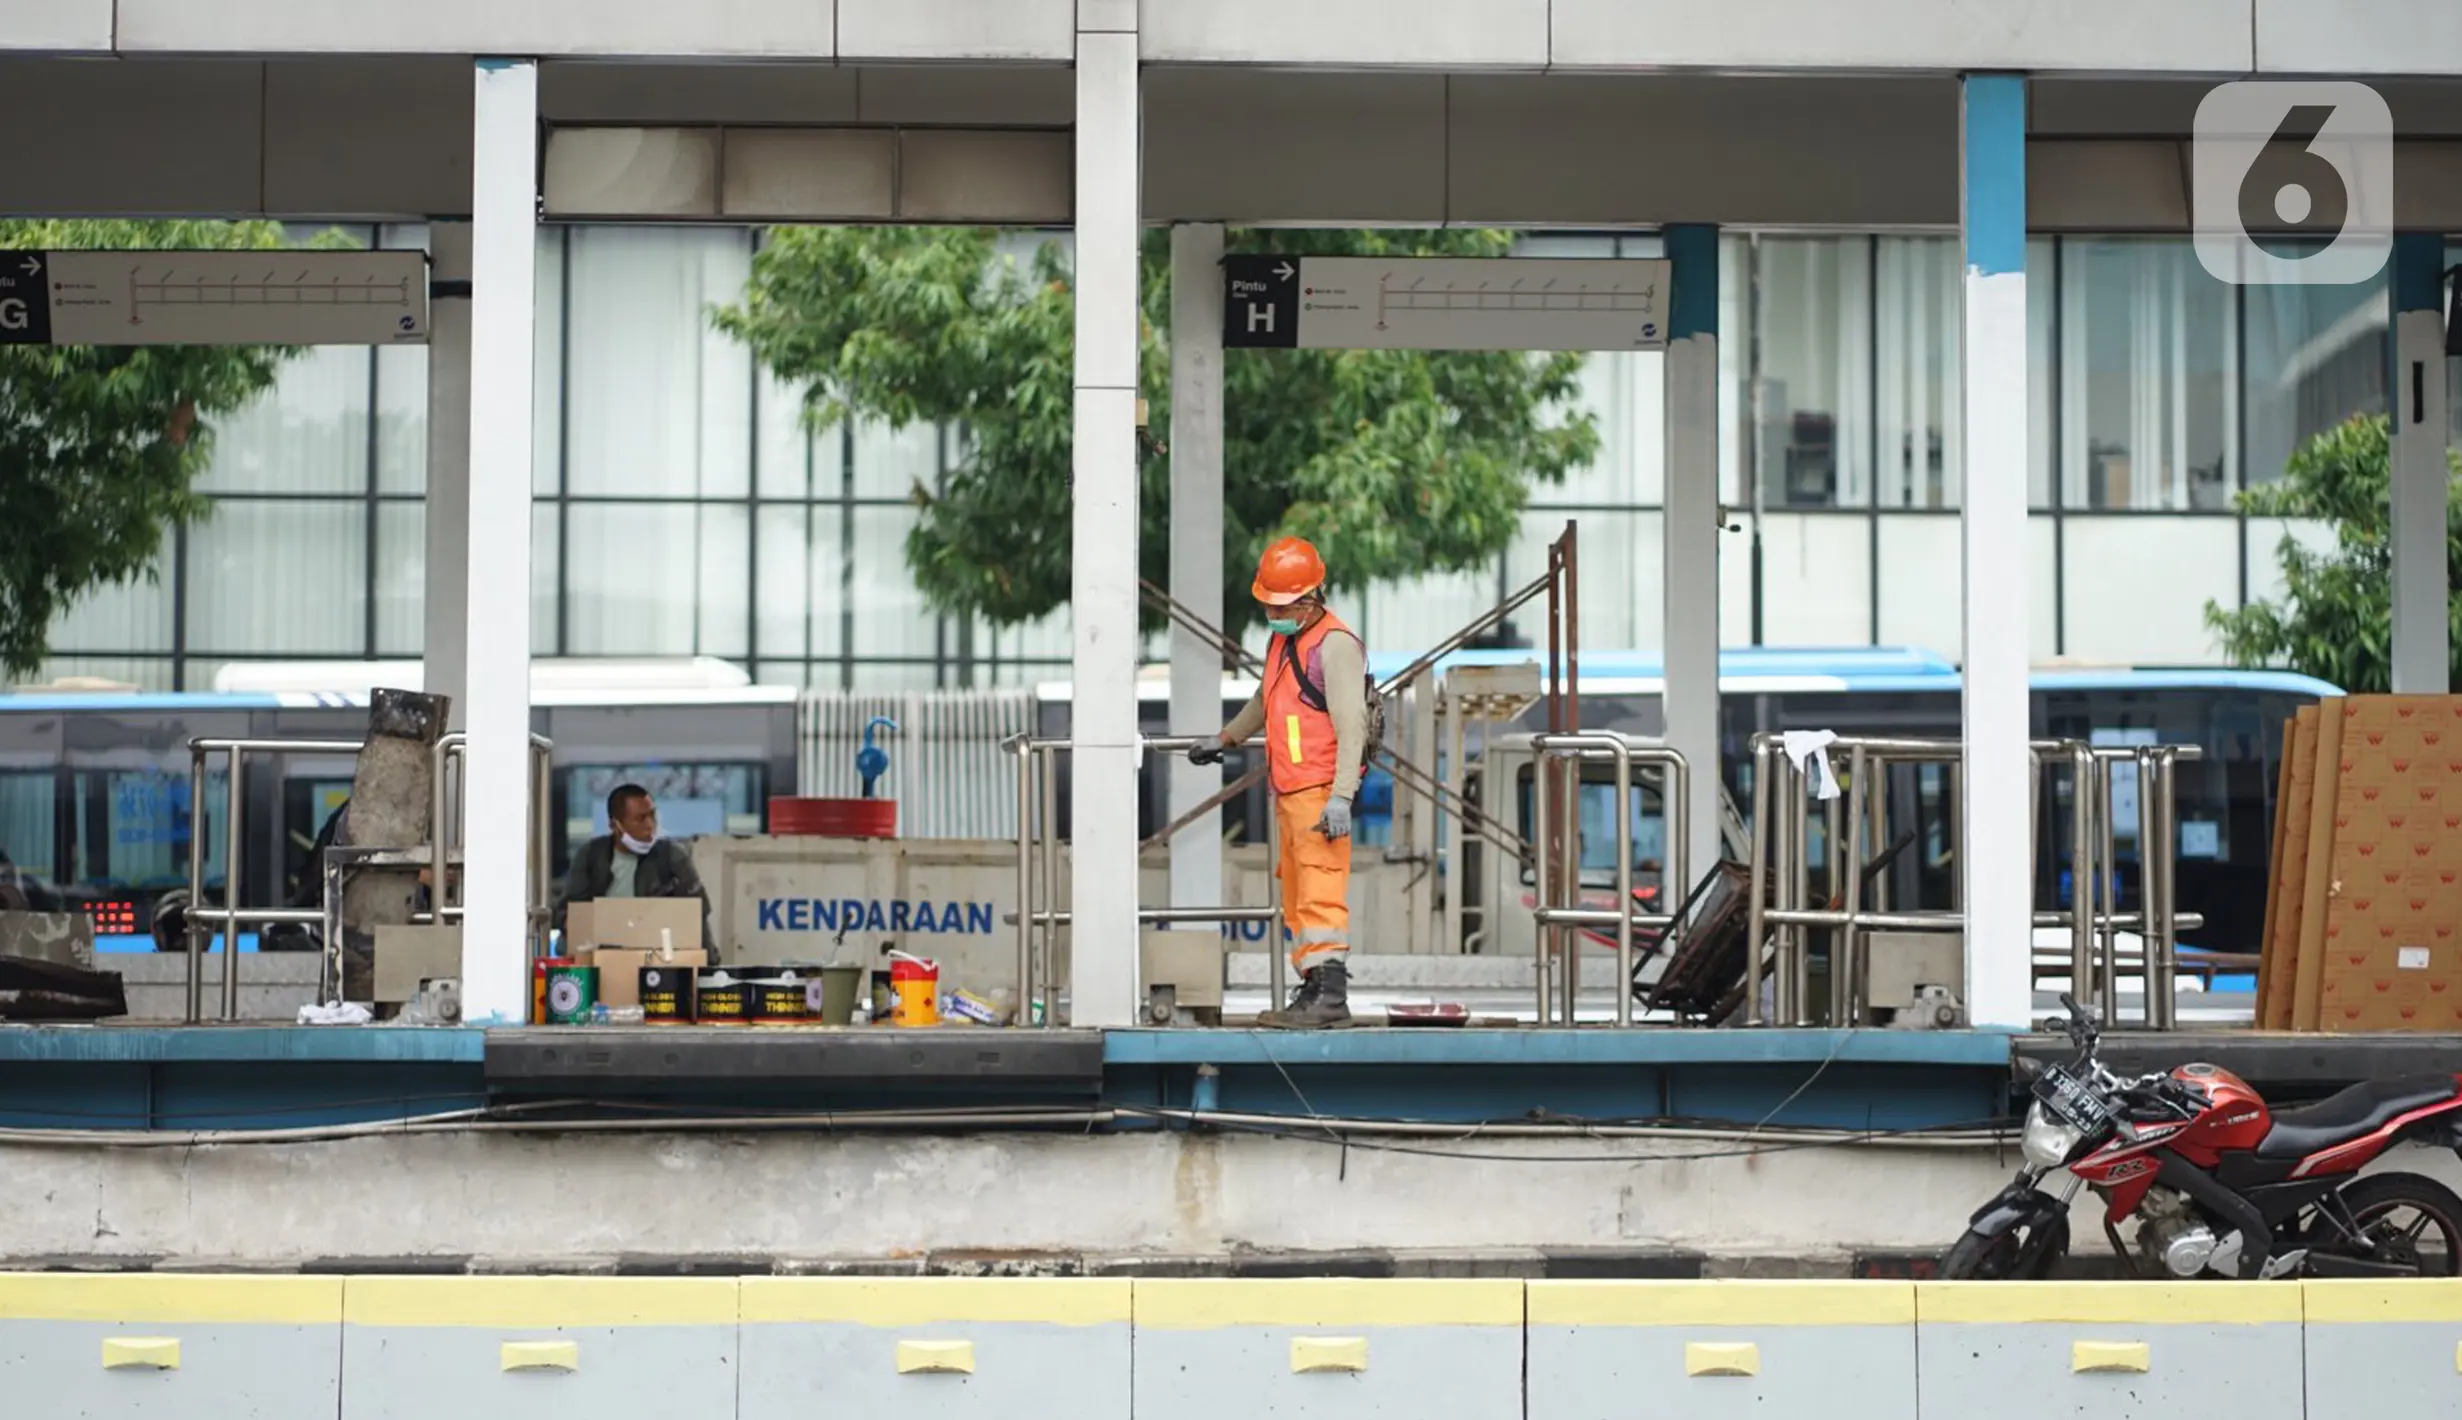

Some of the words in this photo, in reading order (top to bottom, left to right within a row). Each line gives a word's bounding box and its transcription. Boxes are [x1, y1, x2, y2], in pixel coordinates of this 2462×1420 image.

[1232, 280, 1267, 292] Pintu
[0, 298, 28, 329] G
[1248, 303, 1275, 332] H
[758, 898, 993, 934] KENDARAAN
